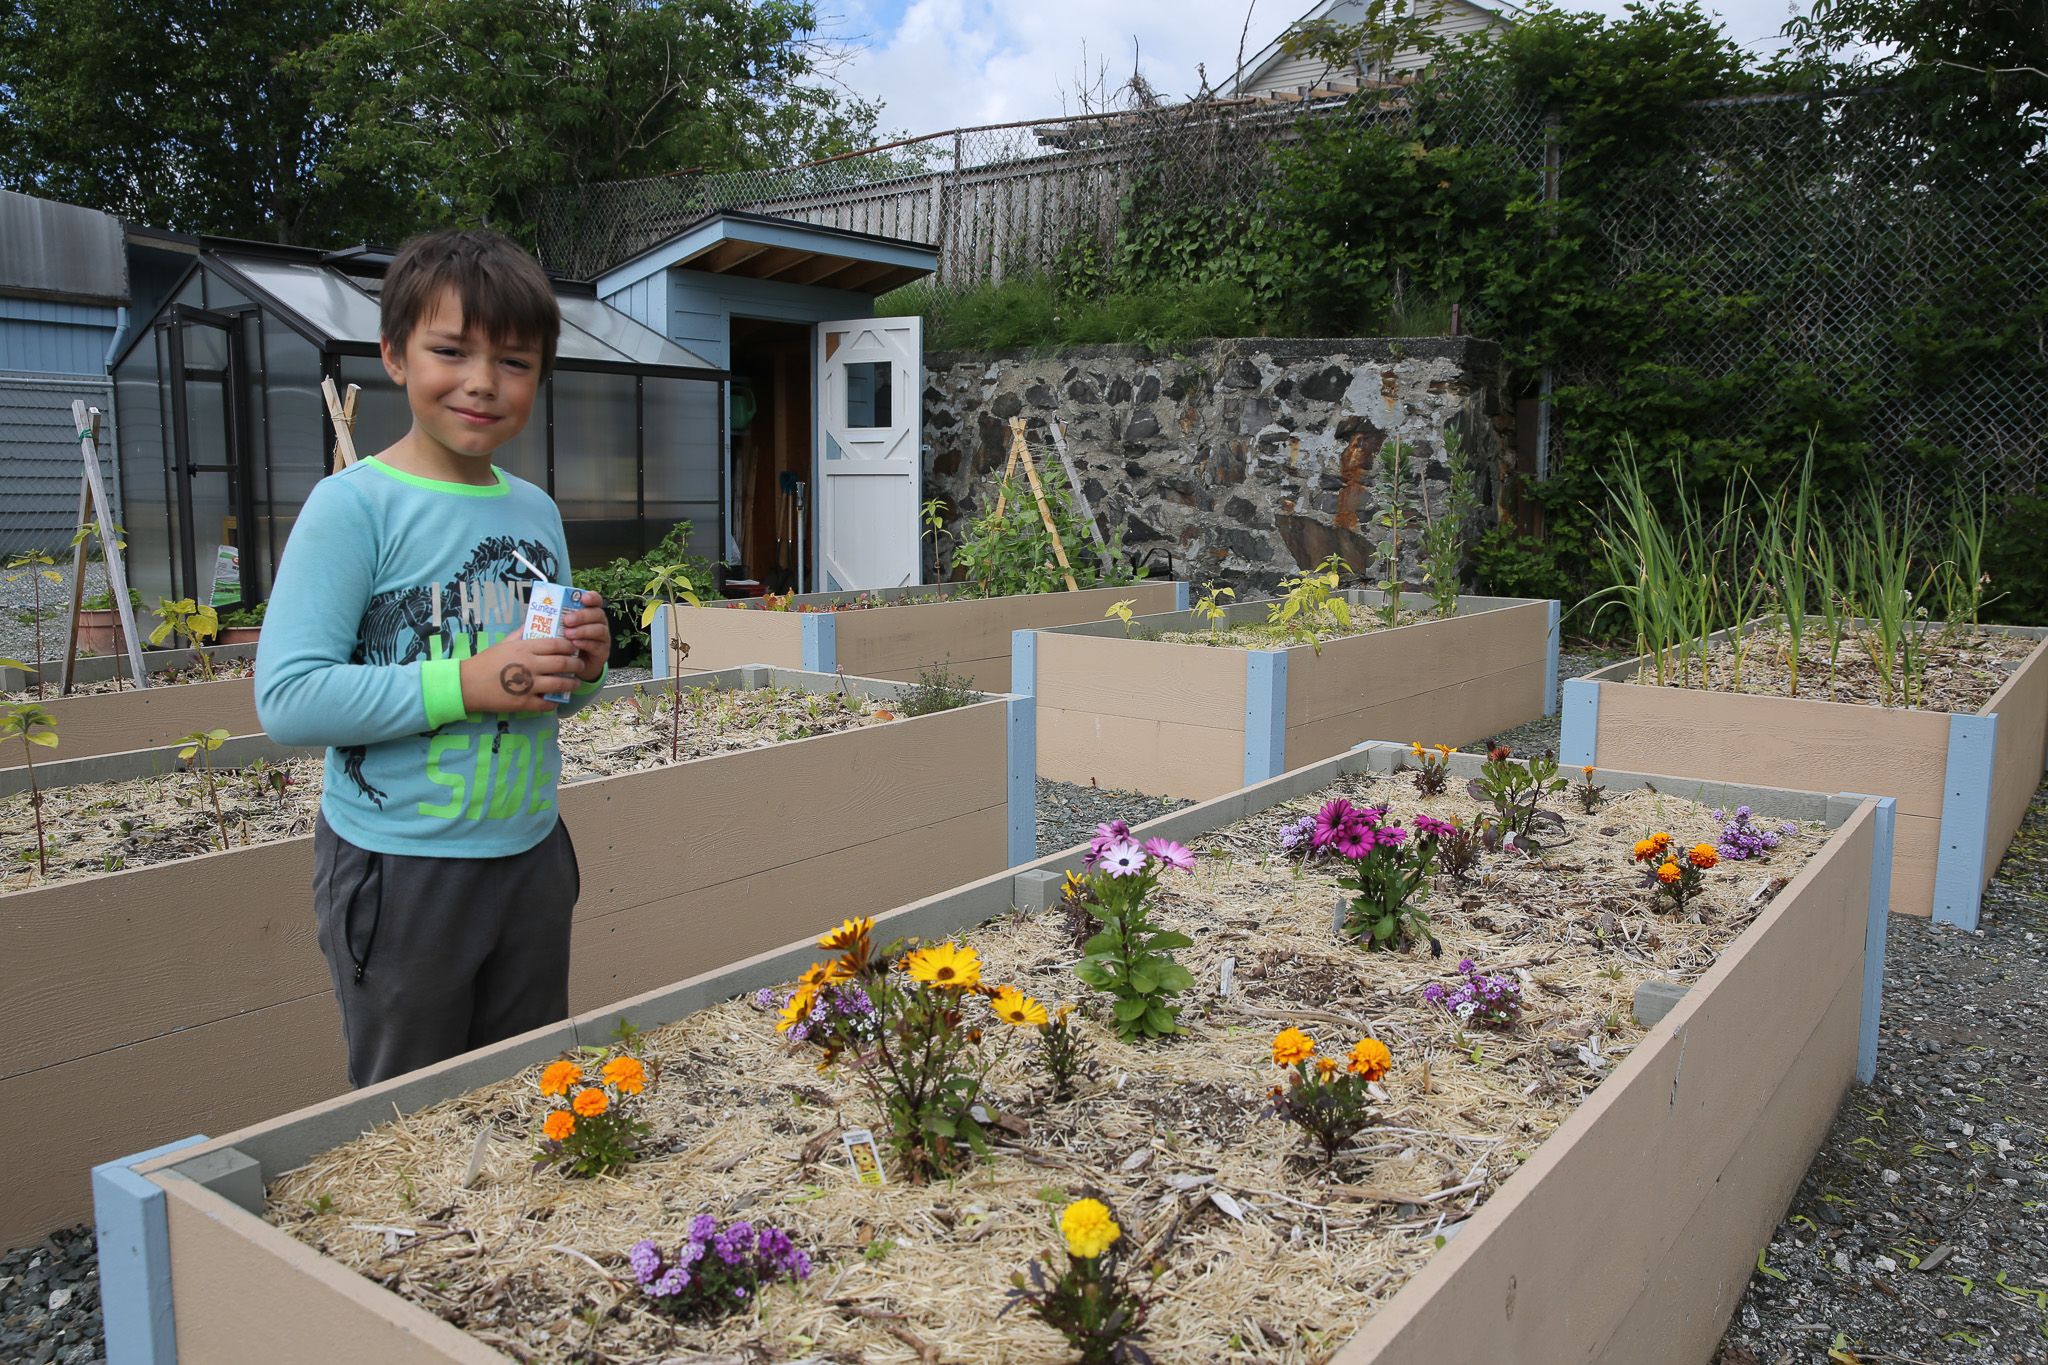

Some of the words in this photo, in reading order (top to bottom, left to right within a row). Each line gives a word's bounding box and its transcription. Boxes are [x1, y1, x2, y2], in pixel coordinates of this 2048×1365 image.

[431, 582, 441, 627] I
[459, 580, 533, 625] HAVE
[530, 623, 551, 634] PLUS
[533, 614, 553, 627] FRUIT
[418, 729, 553, 820] SIDE
